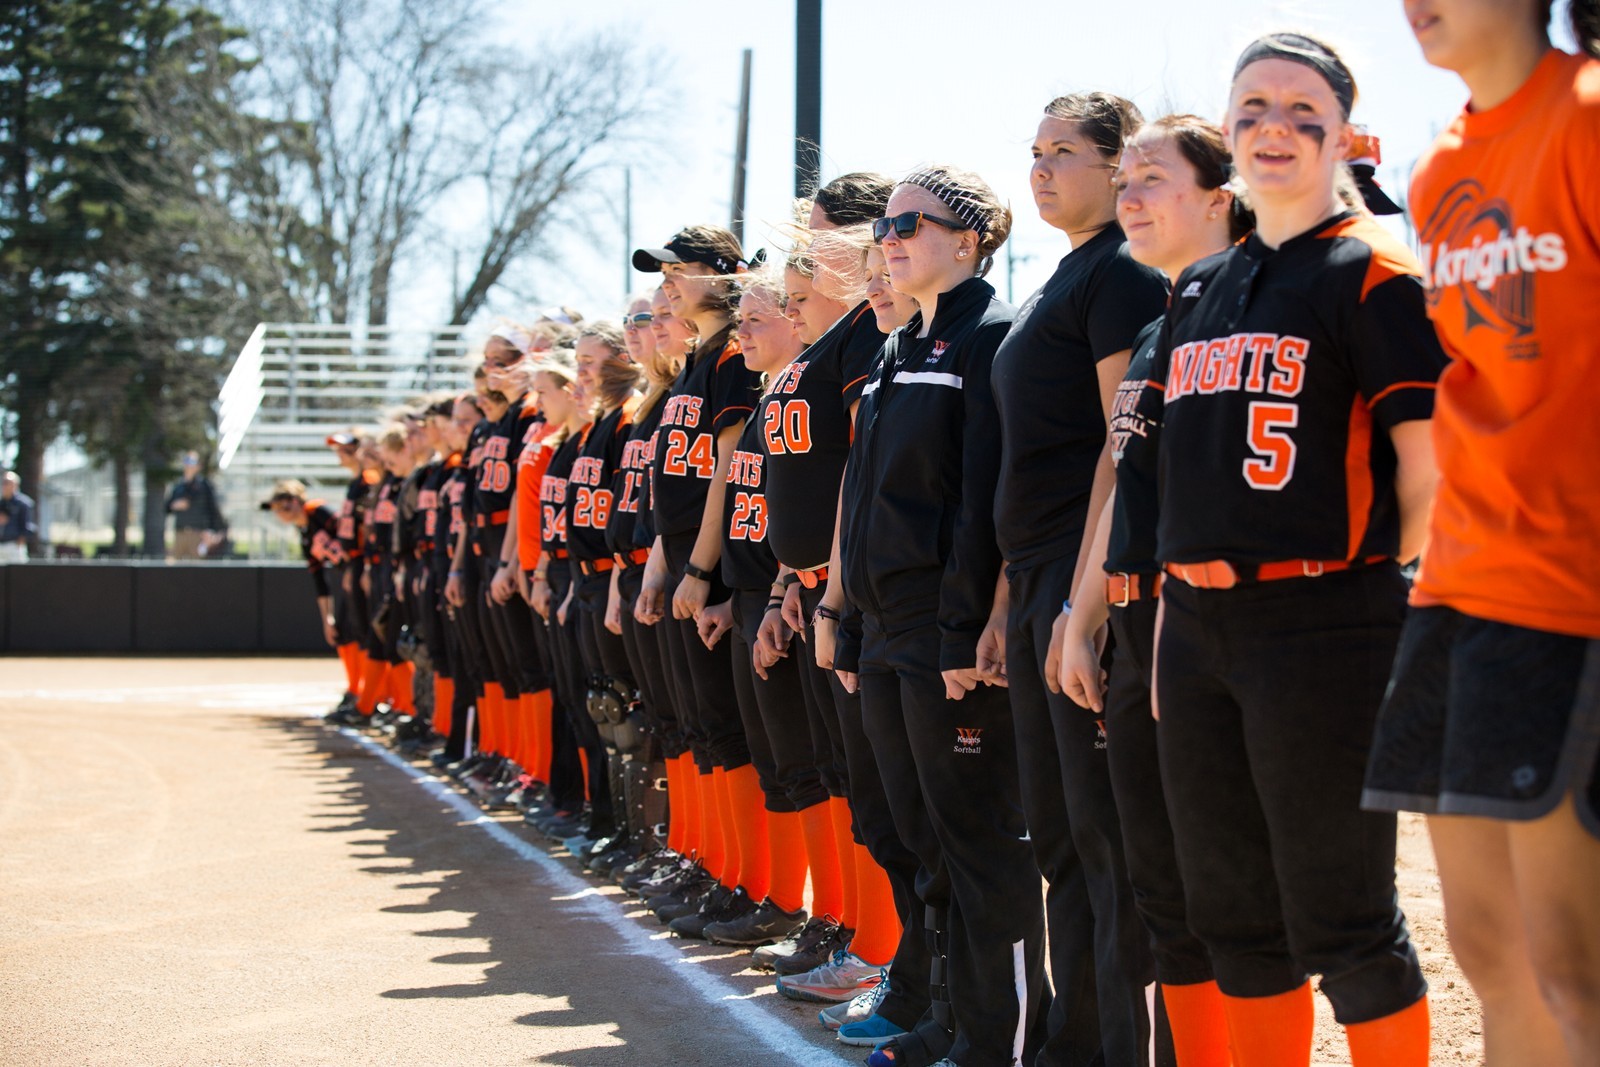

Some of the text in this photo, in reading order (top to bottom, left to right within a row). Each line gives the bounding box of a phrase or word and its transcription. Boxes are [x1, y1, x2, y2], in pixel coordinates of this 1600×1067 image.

[1435, 226, 1568, 290] knights
[1164, 333, 1310, 404] NIGHTS
[764, 399, 812, 455] 20
[1242, 401, 1298, 491] 5
[479, 459, 511, 492] 10
[663, 429, 715, 479] 24
[726, 450, 764, 488] GHTS
[543, 505, 567, 542] 34
[573, 487, 614, 529] 28
[729, 492, 768, 542] 23
[953, 745, 981, 754] Softball
